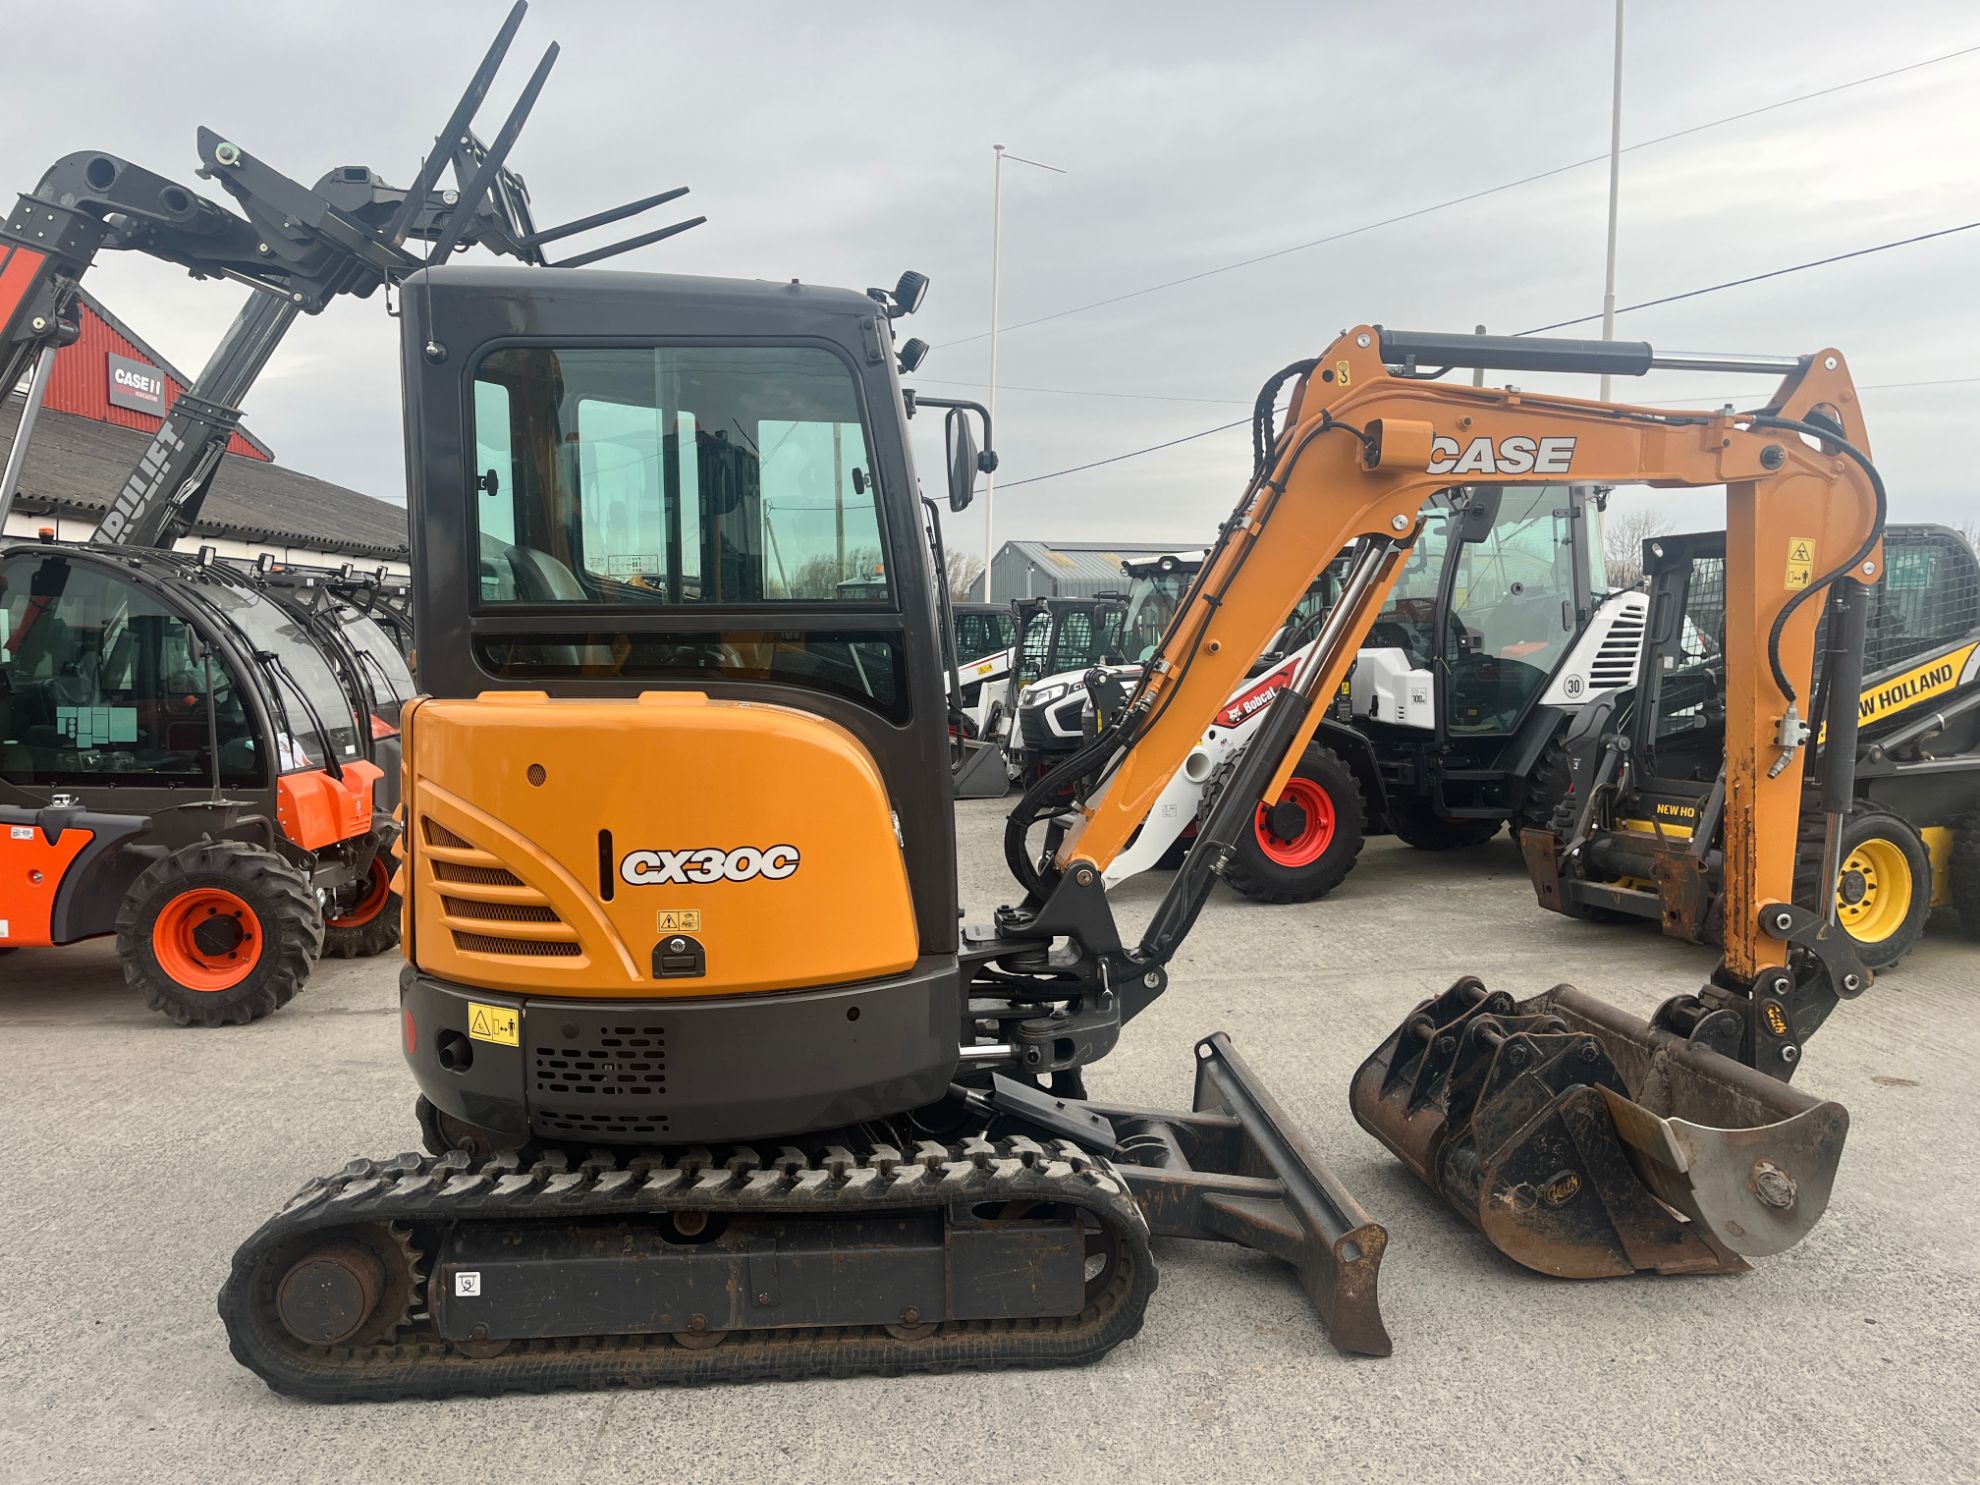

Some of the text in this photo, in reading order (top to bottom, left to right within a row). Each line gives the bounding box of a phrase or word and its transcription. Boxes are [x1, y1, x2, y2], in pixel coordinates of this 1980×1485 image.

[114, 368, 150, 391] CASE
[1425, 435, 1577, 475] CASE
[1243, 686, 1276, 714] Bobcat
[1567, 679, 1580, 693] 30
[1878, 663, 1953, 710] HOLLAND
[1656, 803, 1679, 816] NEW
[620, 843, 801, 886] CX30C
